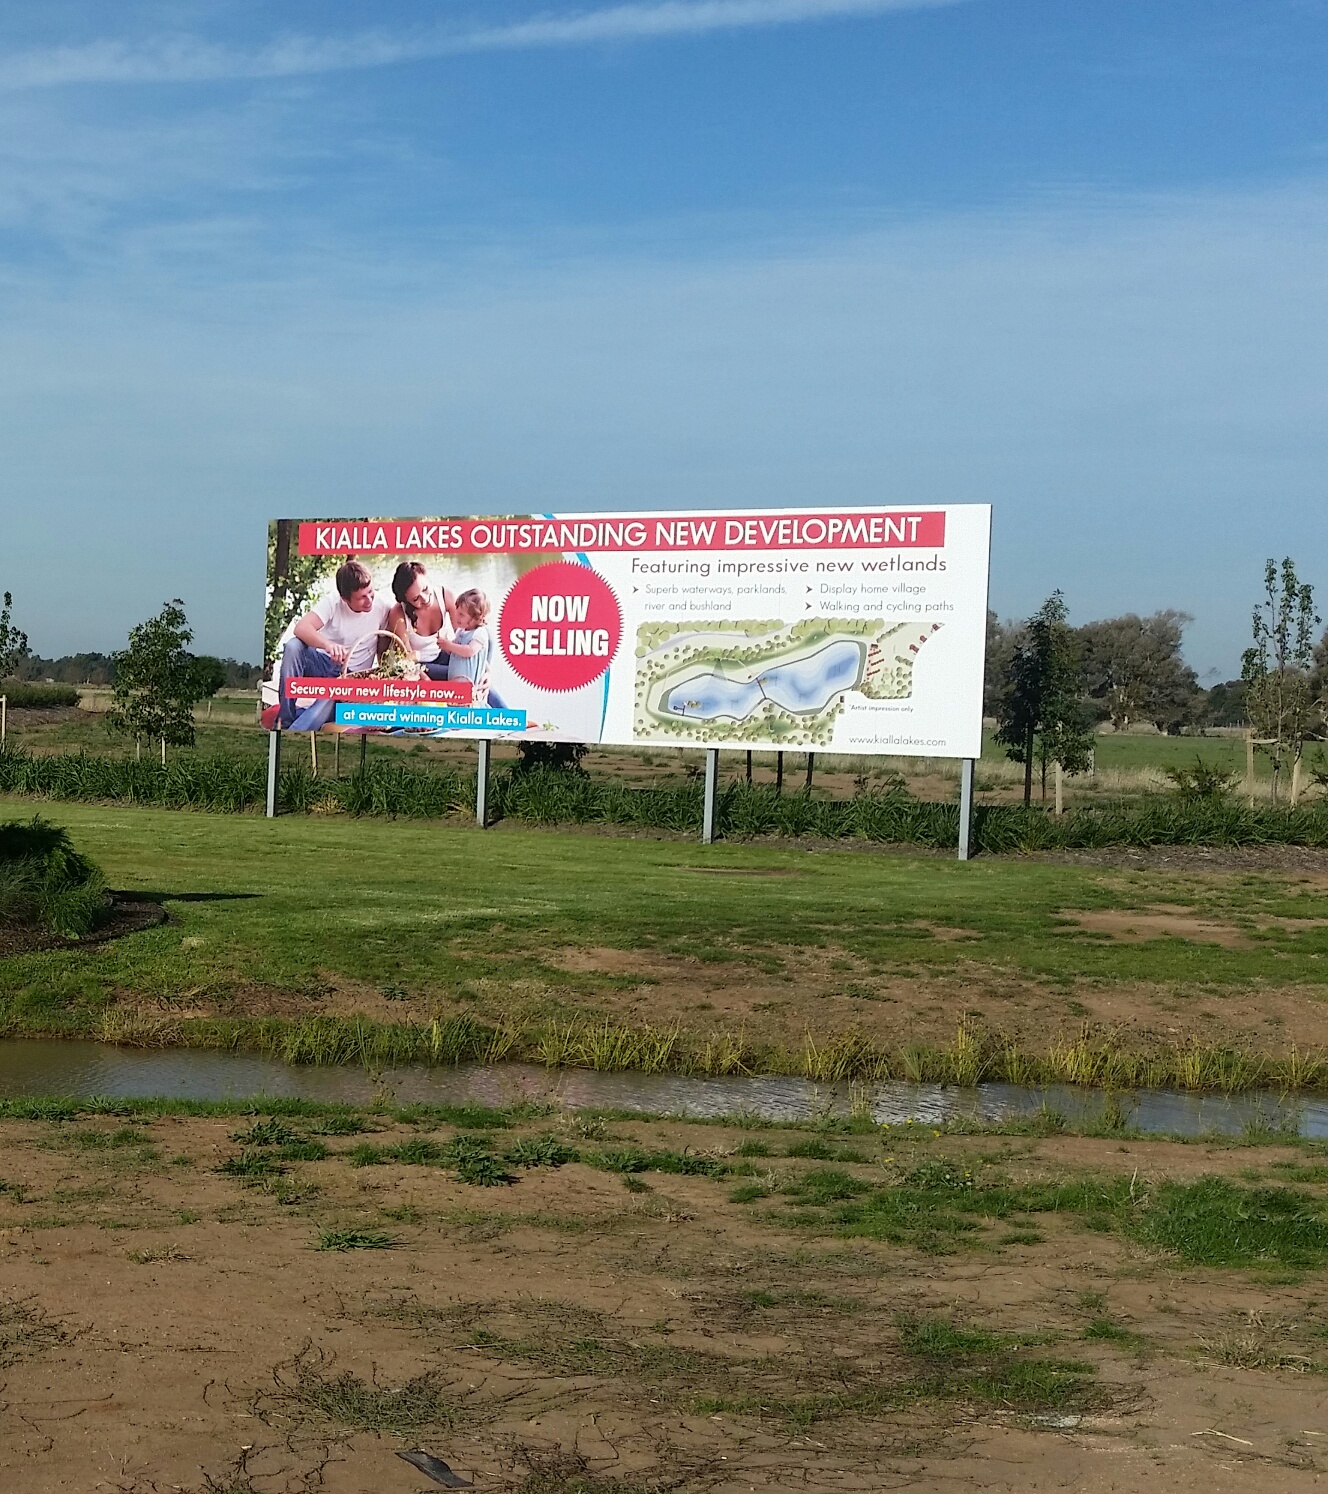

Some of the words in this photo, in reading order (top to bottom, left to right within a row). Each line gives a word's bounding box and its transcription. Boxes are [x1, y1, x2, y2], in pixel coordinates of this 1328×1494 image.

[316, 526, 386, 549] KIALLA
[395, 525, 462, 549] LAKES
[470, 522, 646, 548] OUTSTANDING
[656, 521, 717, 546] NEW
[724, 517, 922, 545] DEVELOPMENT
[632, 558, 710, 577] Featuring
[717, 559, 809, 577] impressive
[816, 560, 855, 572] new
[861, 554, 947, 572] wetlands
[645, 584, 678, 597] Superb
[681, 585, 733, 597] waterways,
[737, 584, 787, 597] parklands,
[820, 584, 857, 597] Display
[860, 584, 888, 595] home
[891, 584, 926, 597] village
[531, 596, 589, 622] NOW
[644, 602, 667, 611] river
[669, 602, 687, 611] and
[690, 601, 731, 611] bushland
[819, 602, 860, 614] Walking
[863, 602, 883, 612] and
[886, 602, 922, 614] cycling
[925, 601, 954, 614] paths
[510, 629, 609, 656] SELLING
[290, 682, 325, 695] Secure
[329, 686, 352, 698] your
[356, 687, 380, 696] new
[383, 684, 427, 699] lifestyle
[429, 688, 464, 699] now...
[343, 711, 356, 720] at
[359, 711, 396, 721] award
[400, 712, 444, 726] winning
[448, 712, 483, 725] Kialla
[486, 713, 521, 726] Lakes.
[849, 735, 946, 746] www.kiallalakes.com
